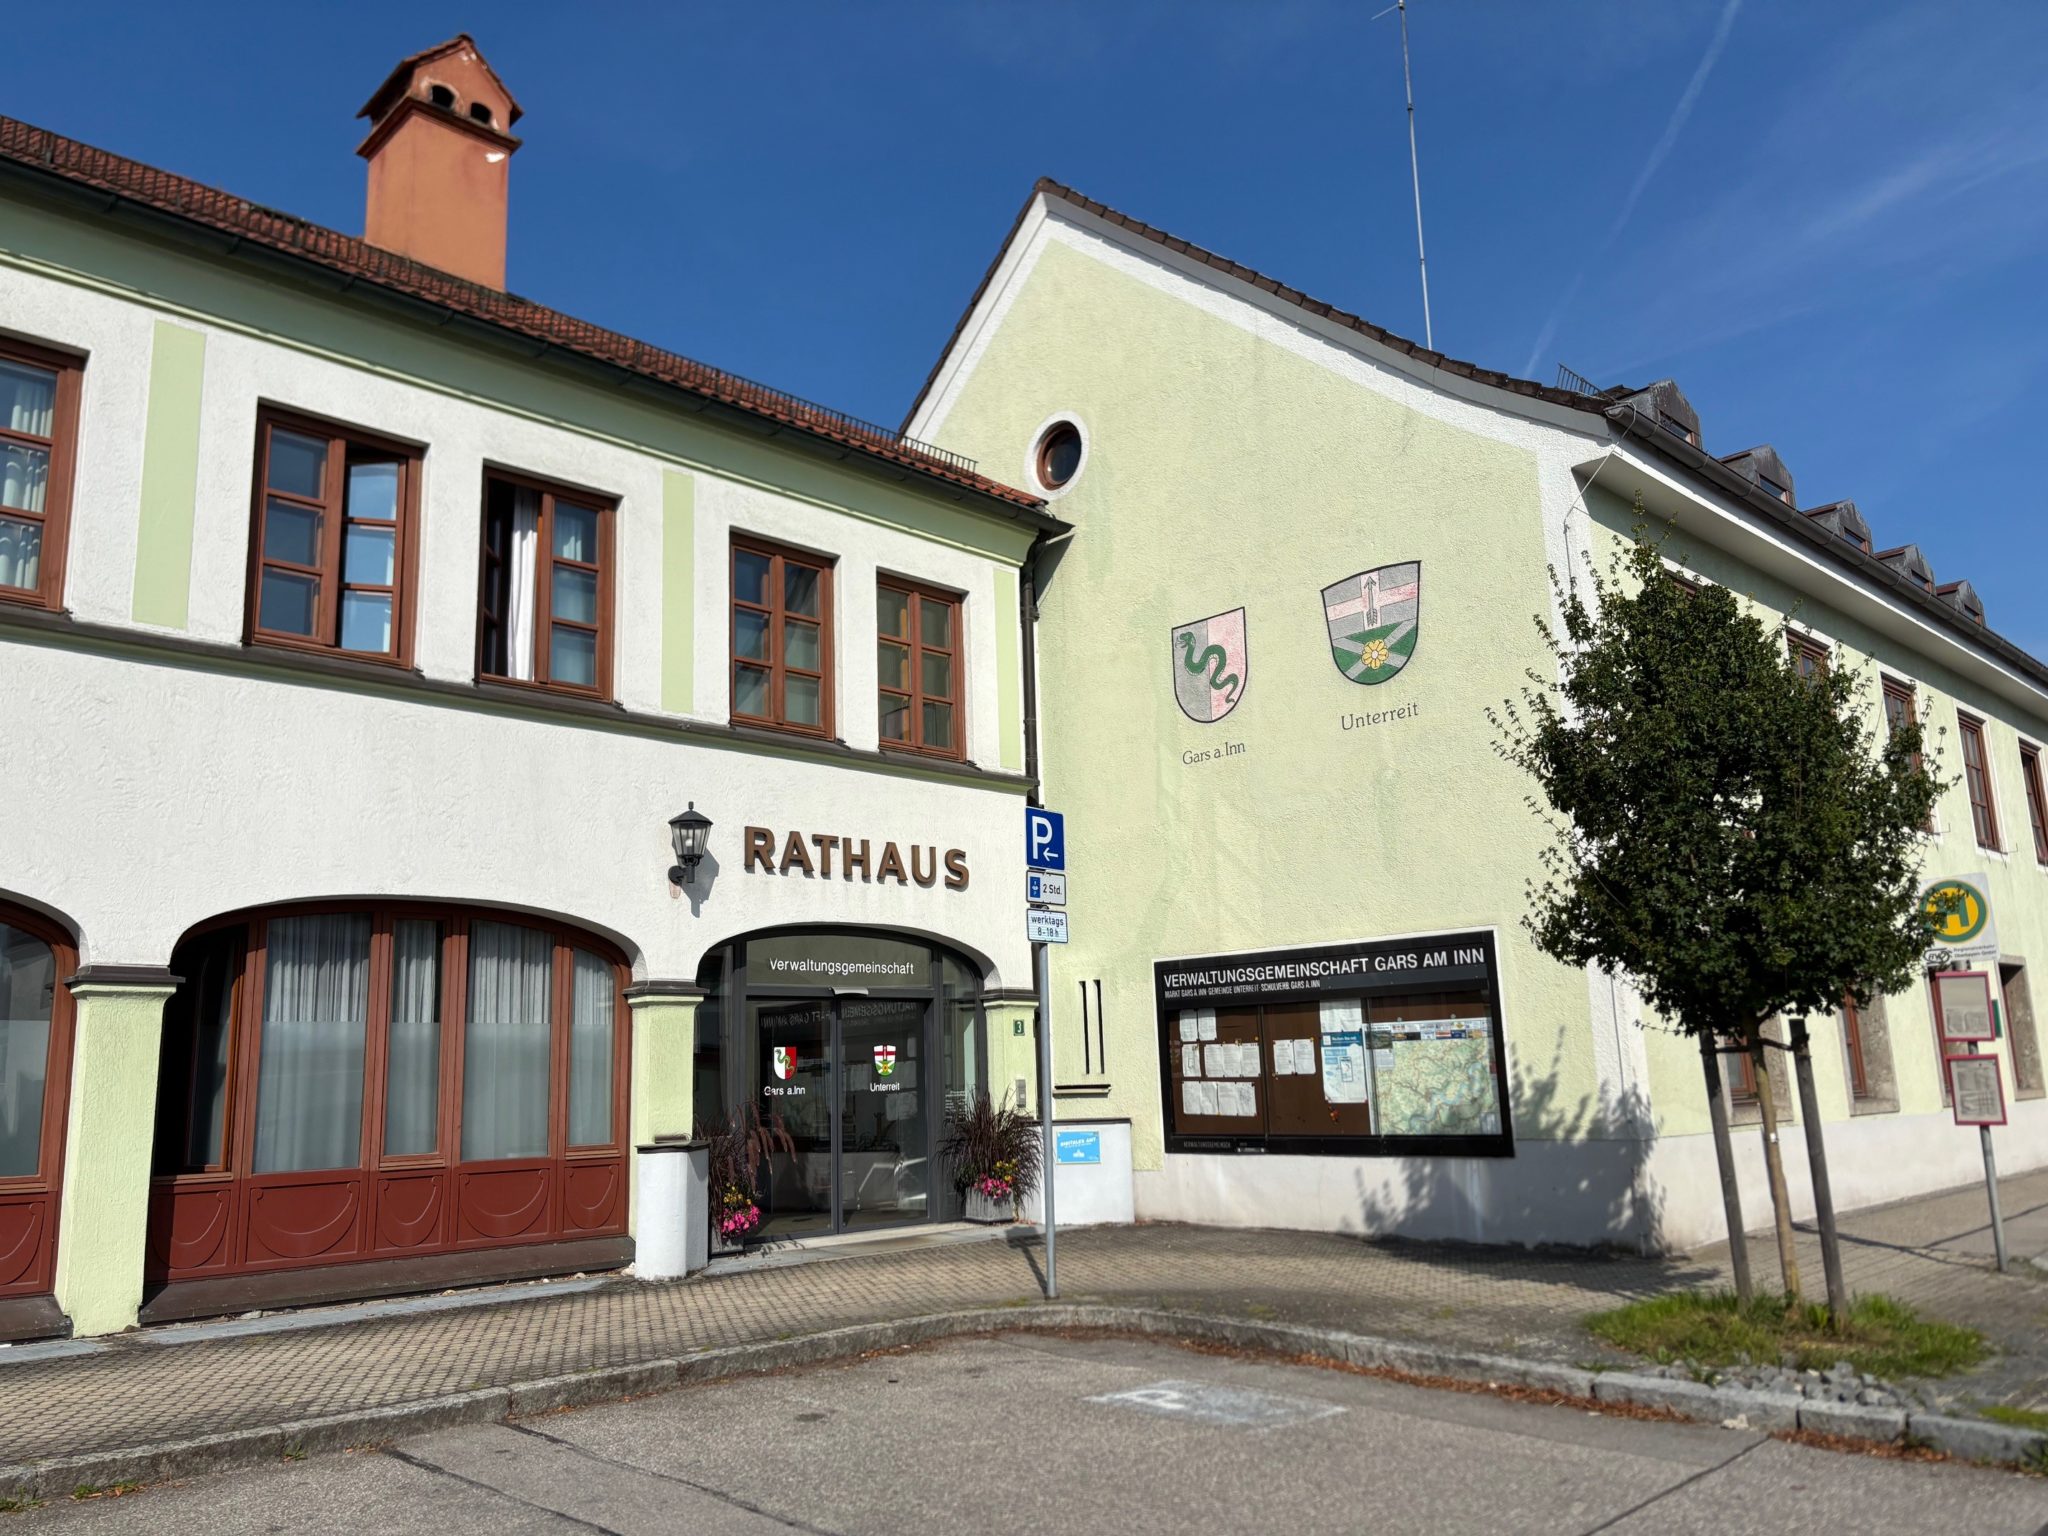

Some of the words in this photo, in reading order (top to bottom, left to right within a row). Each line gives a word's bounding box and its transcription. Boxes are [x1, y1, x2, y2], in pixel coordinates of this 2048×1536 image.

[1341, 702, 1418, 731] Unterreit
[1182, 750, 1211, 765] Gars
[1031, 815, 1053, 860] P
[744, 825, 970, 888] RATHAUS
[1042, 884, 1048, 894] 2
[1048, 885, 1063, 895] Std.
[1031, 914, 1064, 928] werktags
[769, 957, 914, 975] Verwaltungsgemeinschaft
[1164, 957, 1369, 988] VERWALTUNGSGEMEINSCHAFT
[1374, 953, 1418, 972] GARS
[1422, 950, 1448, 968] AM
[1453, 947, 1485, 965] INN
[1291, 980, 1305, 990] GARS
[1016, 1021, 1022, 1033] 3
[763, 1085, 784, 1096] Gars
[869, 1082, 900, 1093] Unterreit
